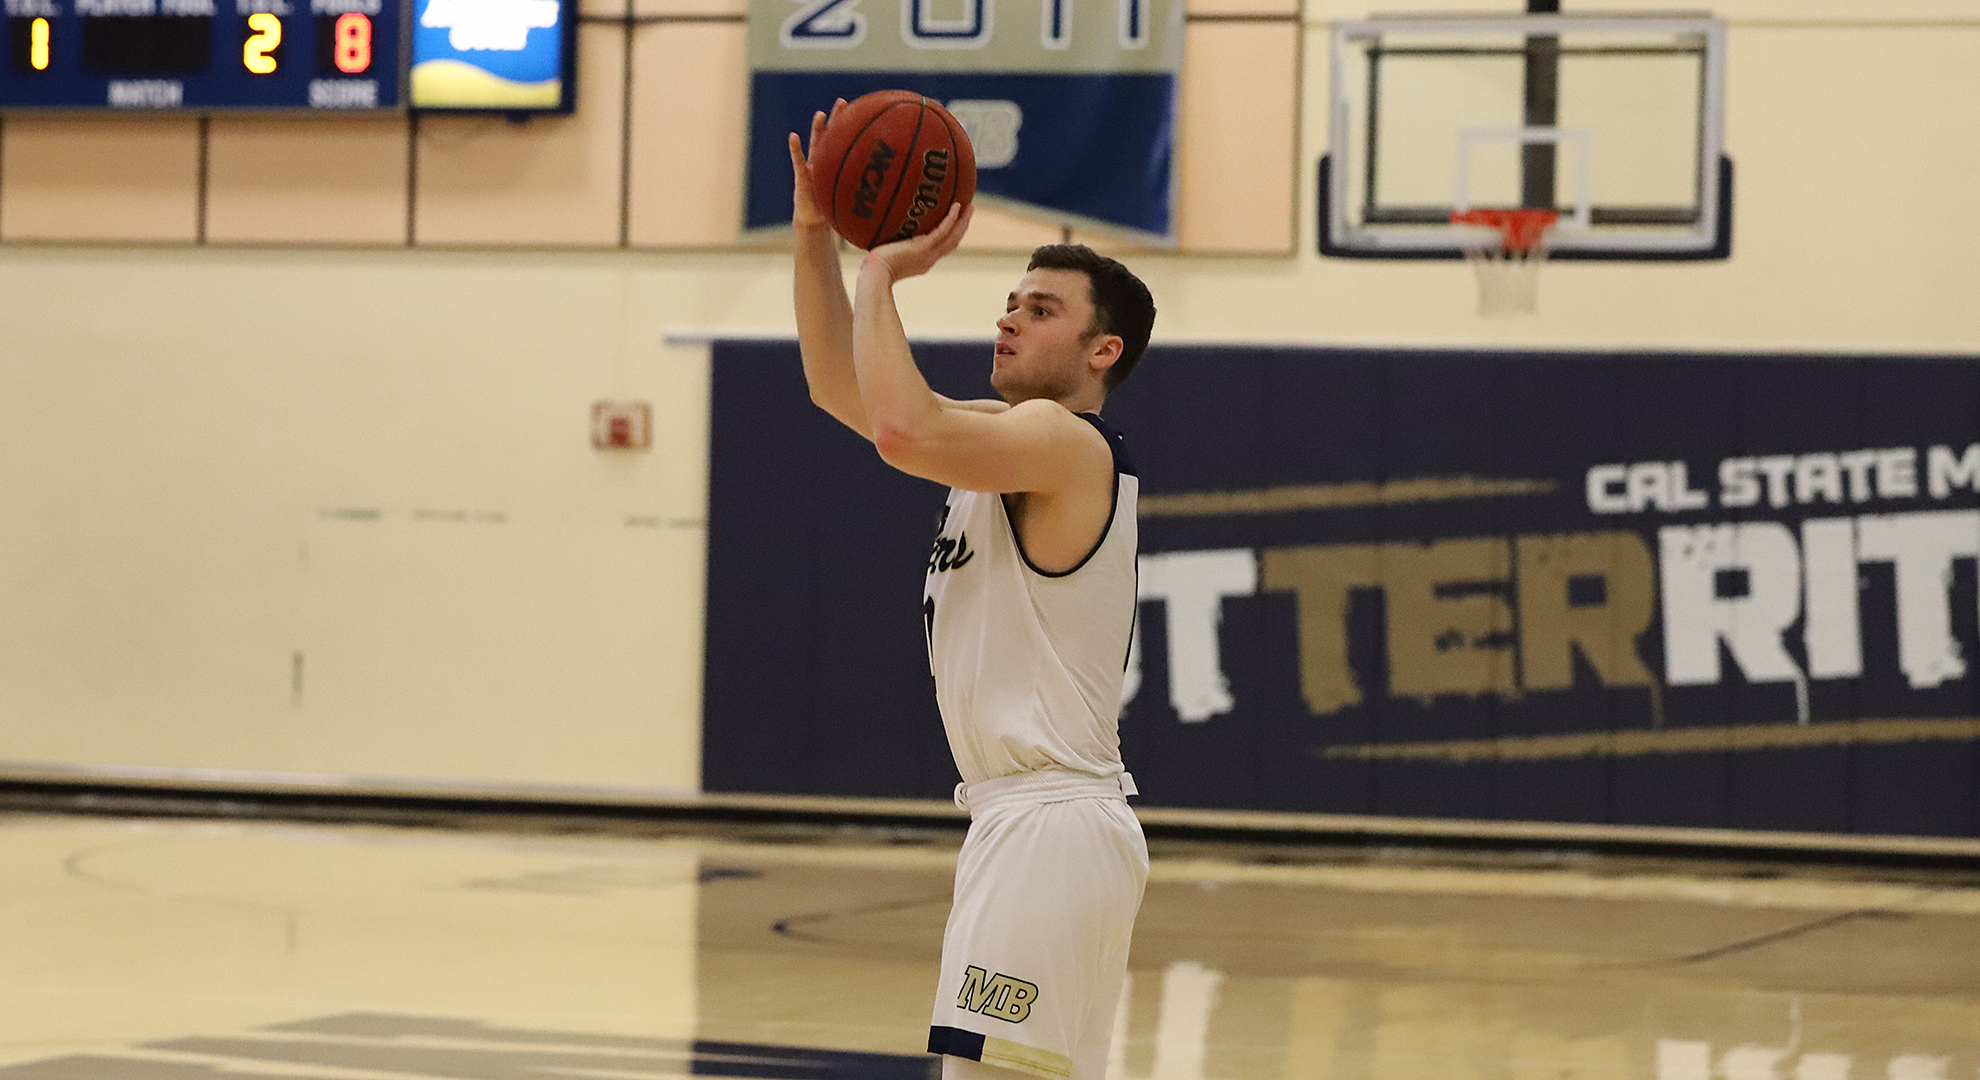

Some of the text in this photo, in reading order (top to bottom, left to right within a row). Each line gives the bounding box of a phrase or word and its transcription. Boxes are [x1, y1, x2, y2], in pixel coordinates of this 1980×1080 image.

[243, 12, 282, 74] 2
[334, 12, 372, 73] 8
[852, 140, 897, 220] NCAA
[890, 149, 949, 242] Wilso
[1586, 460, 1709, 515] CAL
[1718, 446, 1918, 510] STATE
[956, 964, 1039, 1024] MB
